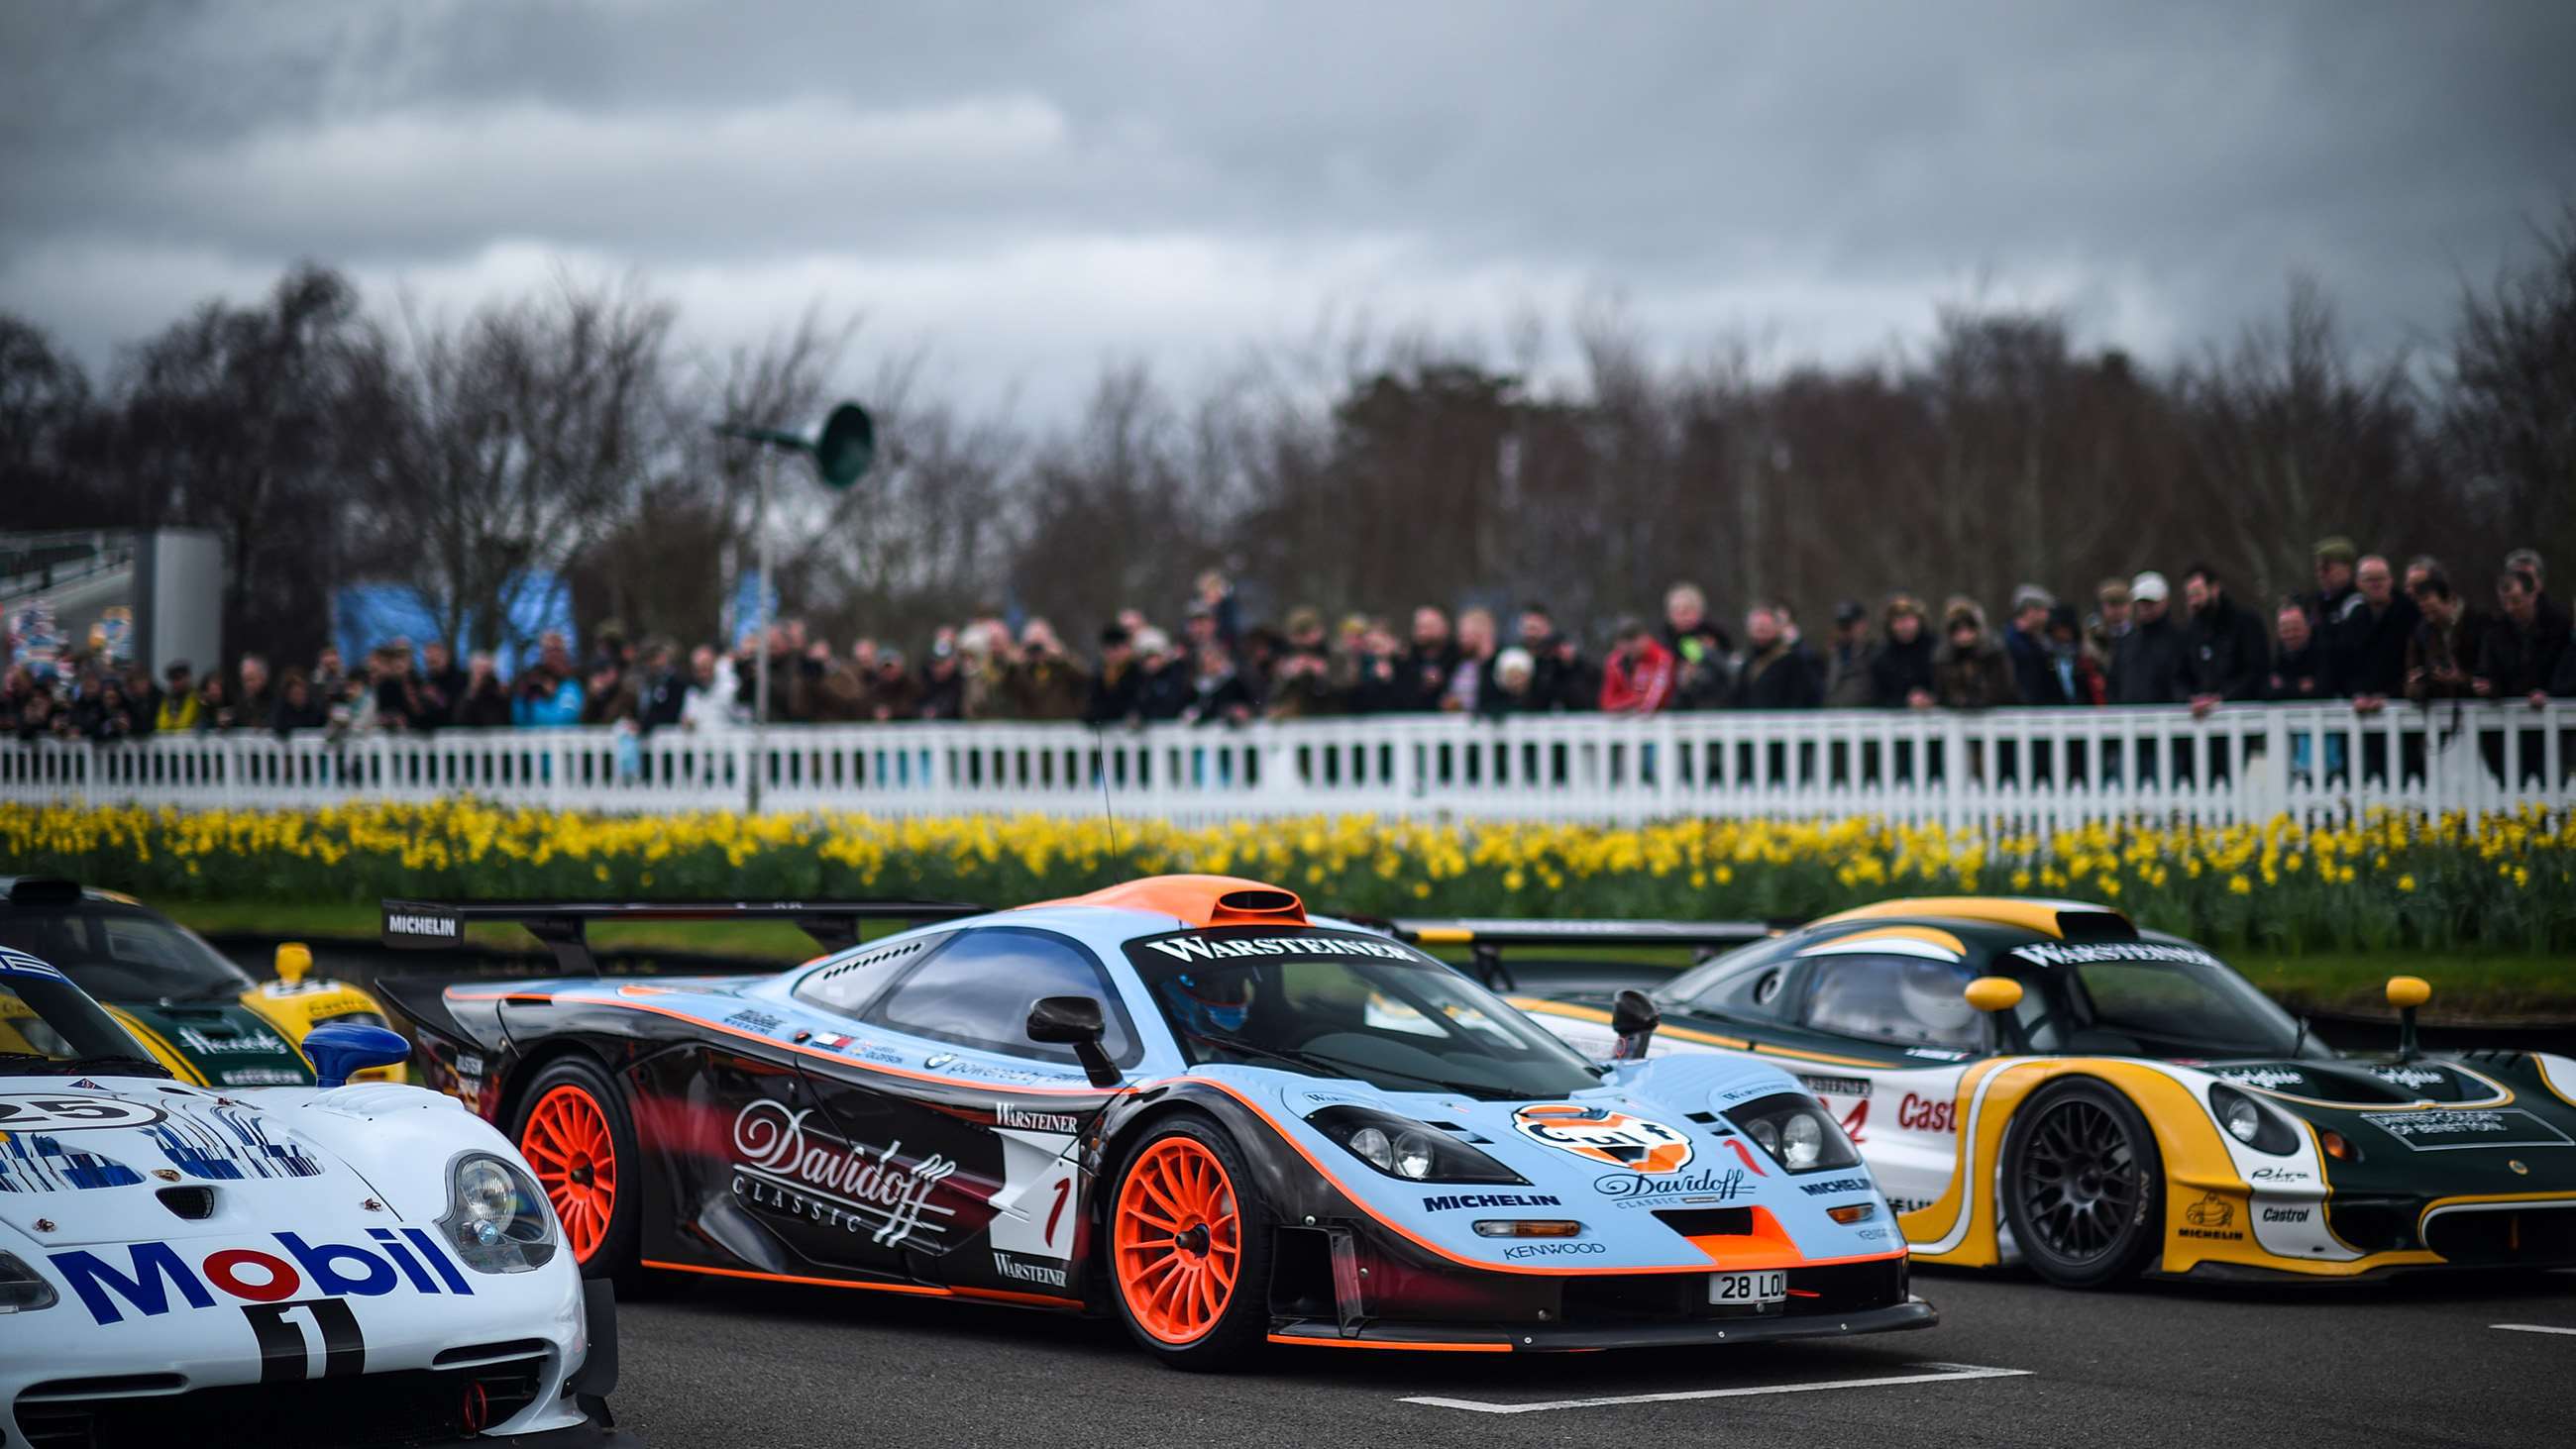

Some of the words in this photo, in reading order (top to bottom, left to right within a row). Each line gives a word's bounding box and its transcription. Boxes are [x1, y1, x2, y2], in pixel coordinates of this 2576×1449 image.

[389, 914, 456, 937] MICHELIN
[1146, 935, 1420, 964] WARSTEINER
[2011, 942, 2220, 968] WARSTEINER
[995, 1101, 1078, 1133] WARSTEINER
[734, 1099, 956, 1248] Davidoff
[1593, 1169, 1756, 1204] Davidoff
[731, 1176, 862, 1233] CLASSIC
[1044, 1177, 1071, 1249] 1
[1423, 1194, 1561, 1212] MICHELIN
[1616, 1195, 1677, 1209] CLASSIC
[2262, 1207, 2310, 1223] Castrol
[2178, 1227, 2243, 1241] MICHELIN
[1503, 1243, 1606, 1260] KENWOOD
[47, 1228, 475, 1325] Mobil
[993, 1252, 1067, 1288] WARSTEINER
[1721, 1276, 1751, 1298] 28
[278, 1305, 327, 1381] 1
